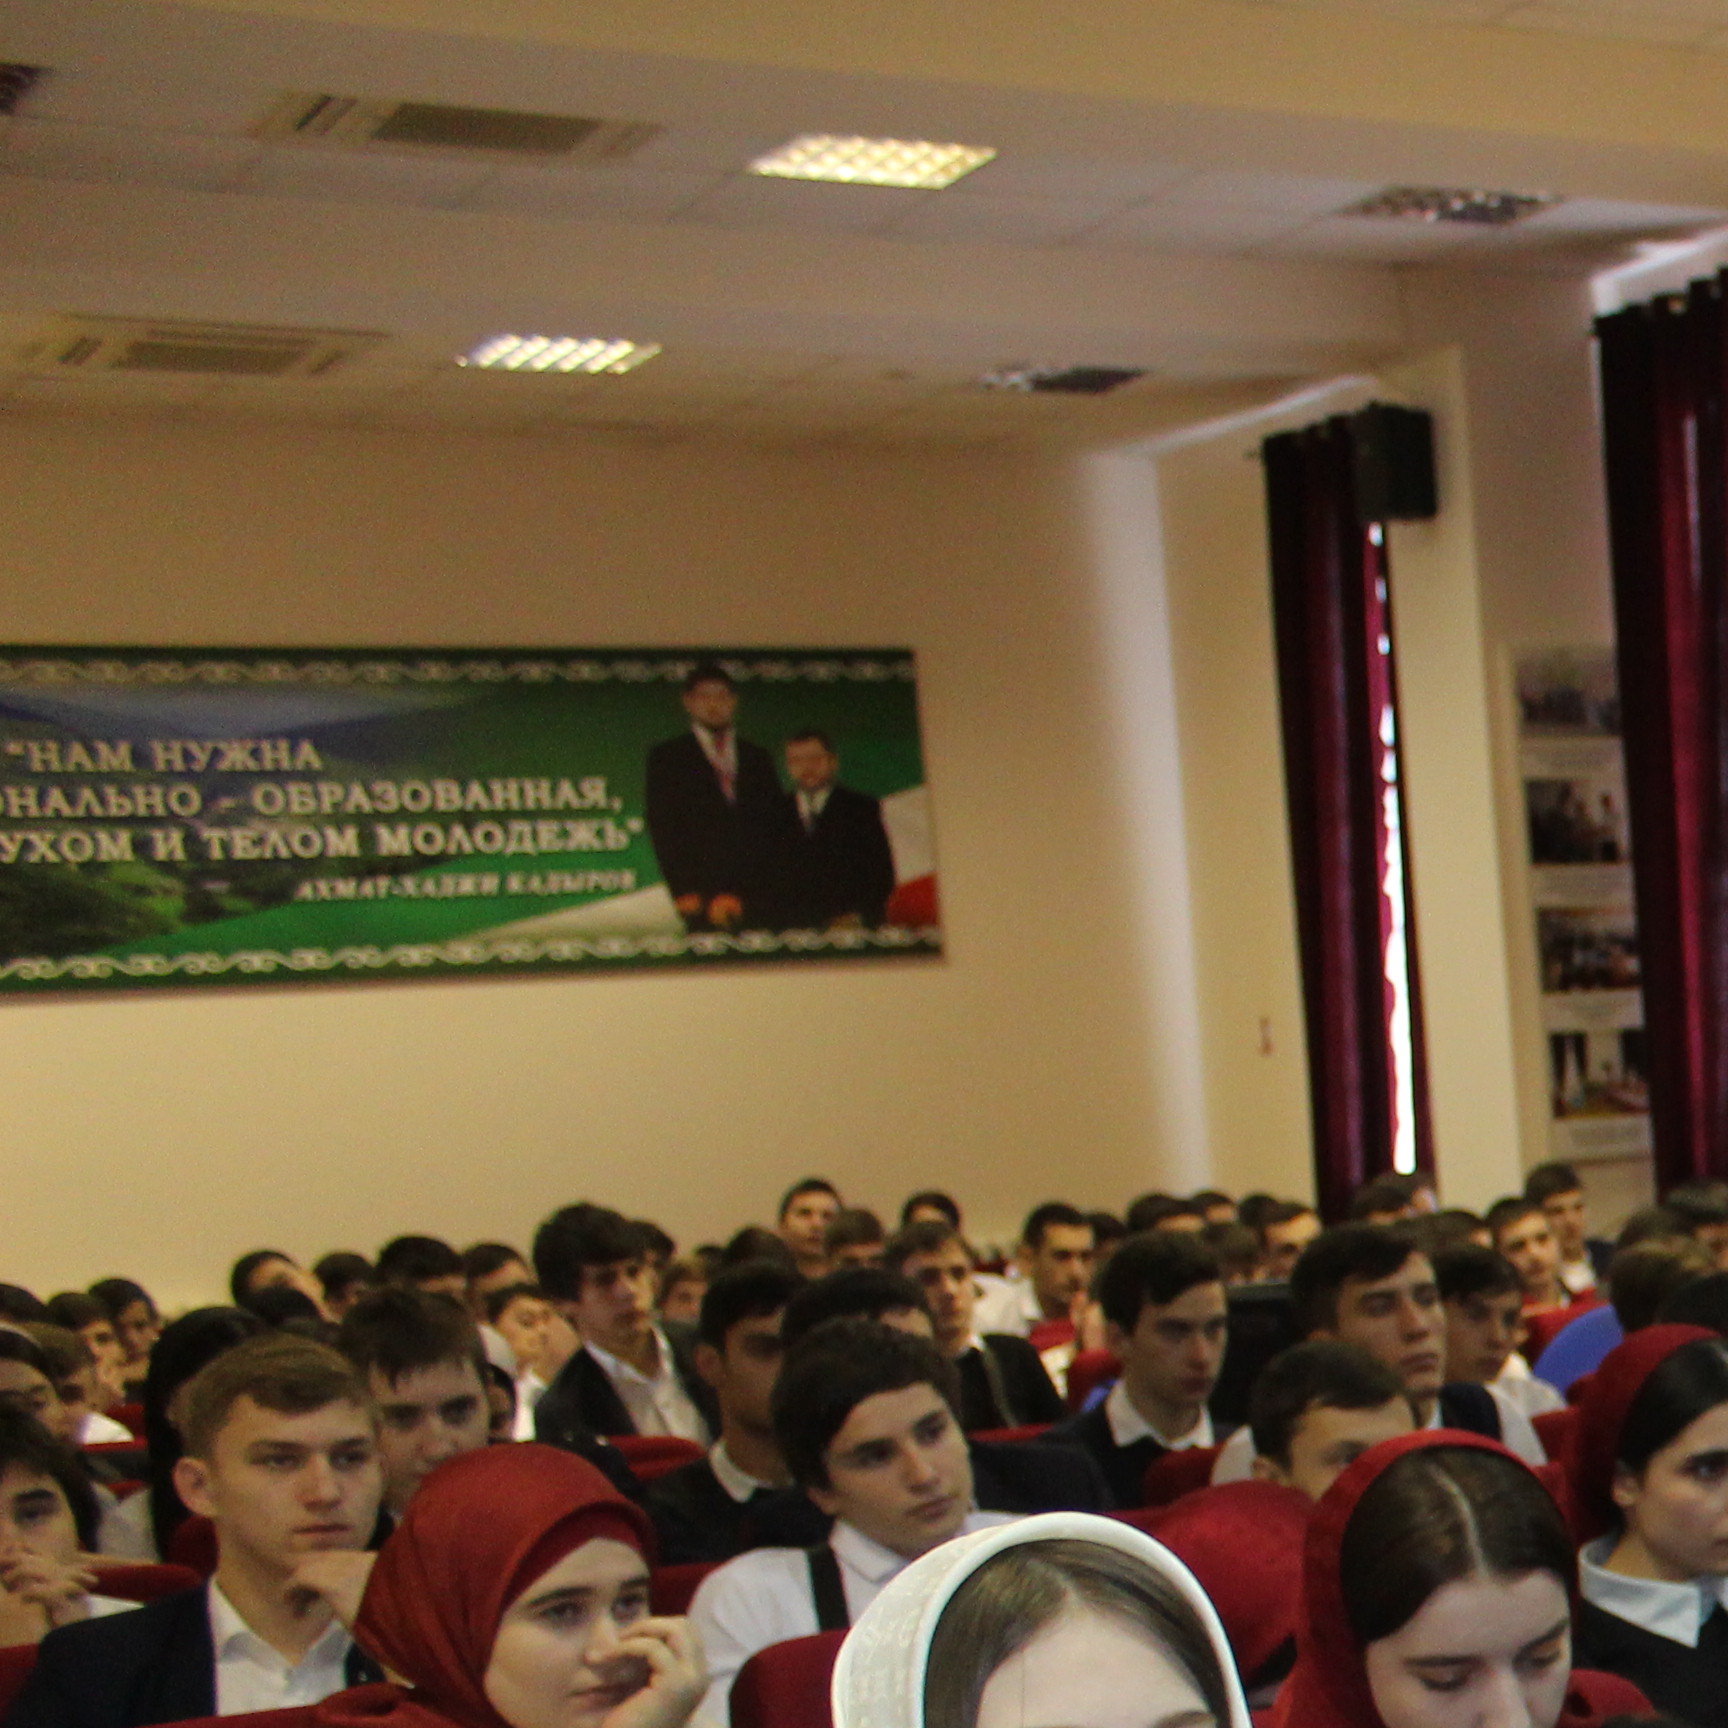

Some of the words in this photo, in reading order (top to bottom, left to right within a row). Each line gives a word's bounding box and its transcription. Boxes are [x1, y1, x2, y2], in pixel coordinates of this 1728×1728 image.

[150, 738, 323, 773] НУЖНА
[0, 784, 202, 819] НАЛЬНО
[250, 777, 623, 818] ОБРАЗОВАННАЯ,
[151, 829, 187, 863] И
[201, 825, 361, 862] ТЕЛОМ
